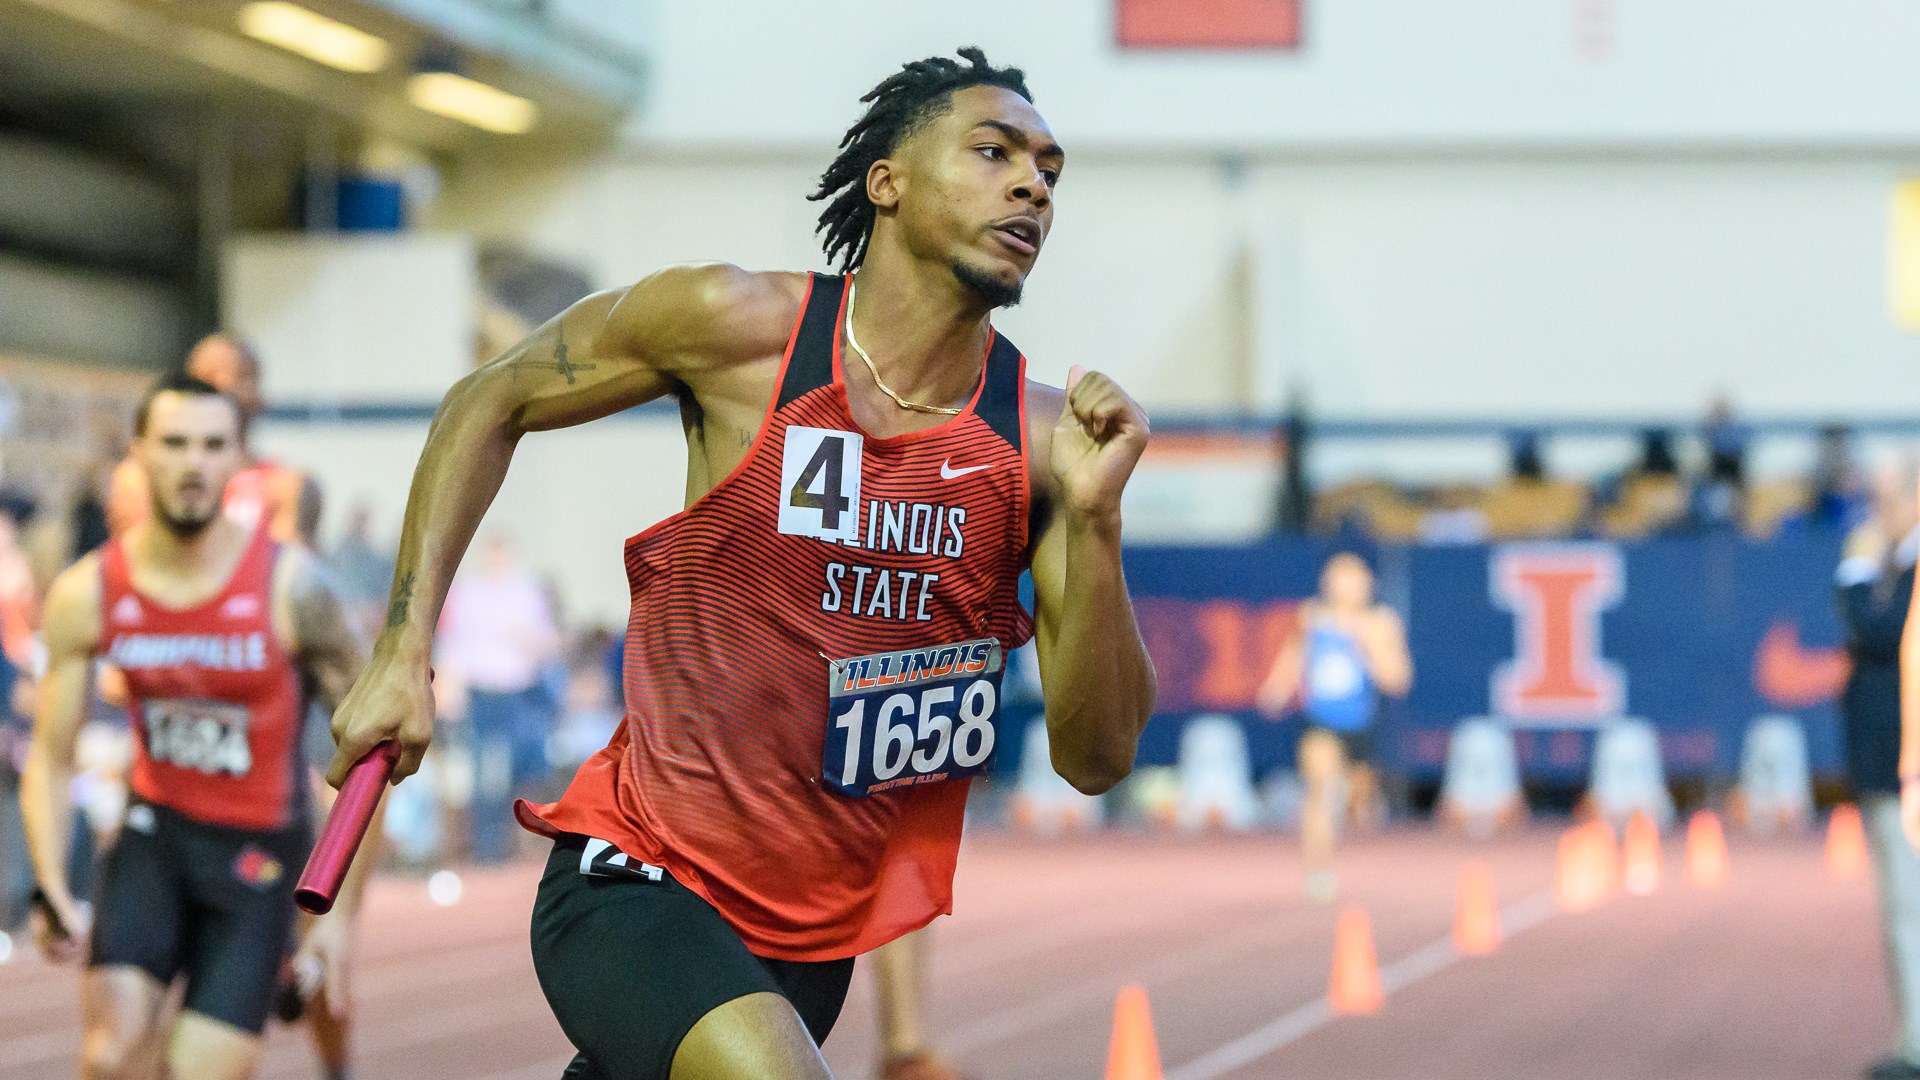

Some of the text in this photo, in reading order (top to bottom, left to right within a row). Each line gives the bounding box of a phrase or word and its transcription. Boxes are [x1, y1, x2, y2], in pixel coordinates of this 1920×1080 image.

[789, 435, 850, 531] 4
[804, 499, 966, 559] INOIS
[821, 561, 940, 622] STATE
[843, 642, 993, 692] ILLINOIS
[1492, 544, 1624, 724] I
[835, 679, 996, 787] 1658
